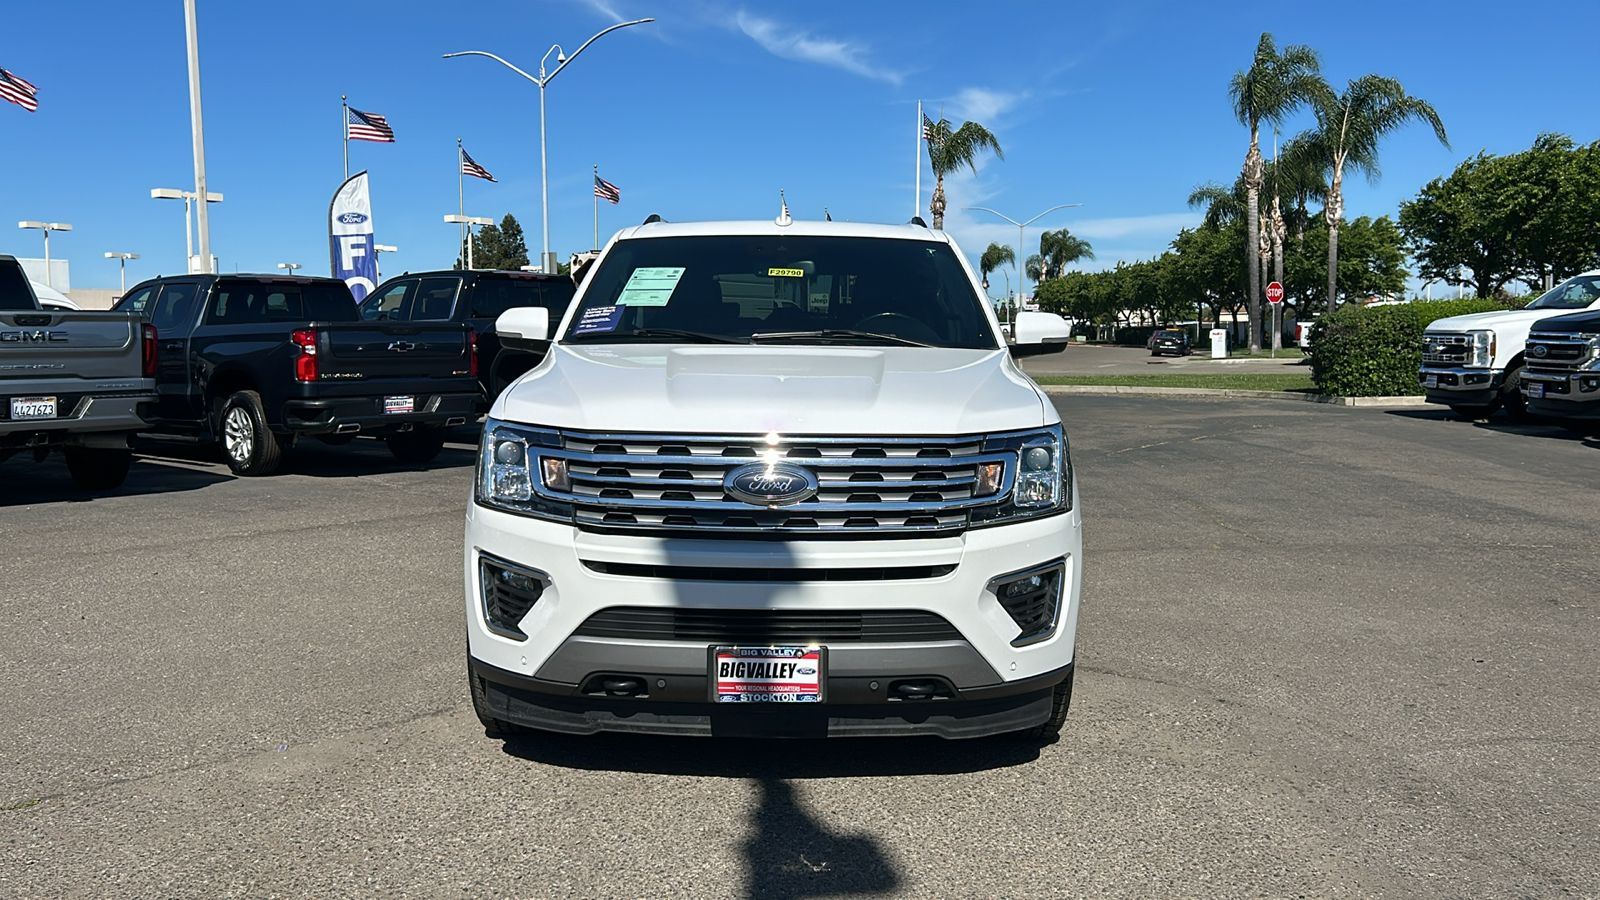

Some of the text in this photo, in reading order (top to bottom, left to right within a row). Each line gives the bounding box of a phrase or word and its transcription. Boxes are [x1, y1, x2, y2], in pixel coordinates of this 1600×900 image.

[342, 213, 363, 223] Ford
[1268, 288, 1282, 297] STOP
[811, 297, 828, 305] Jeep
[0, 331, 69, 342] GMC
[748, 473, 793, 491] Ford
[760, 649, 796, 657] VALLEY
[719, 662, 797, 679] BIGVALLEY
[740, 693, 797, 701] STOCKTON
